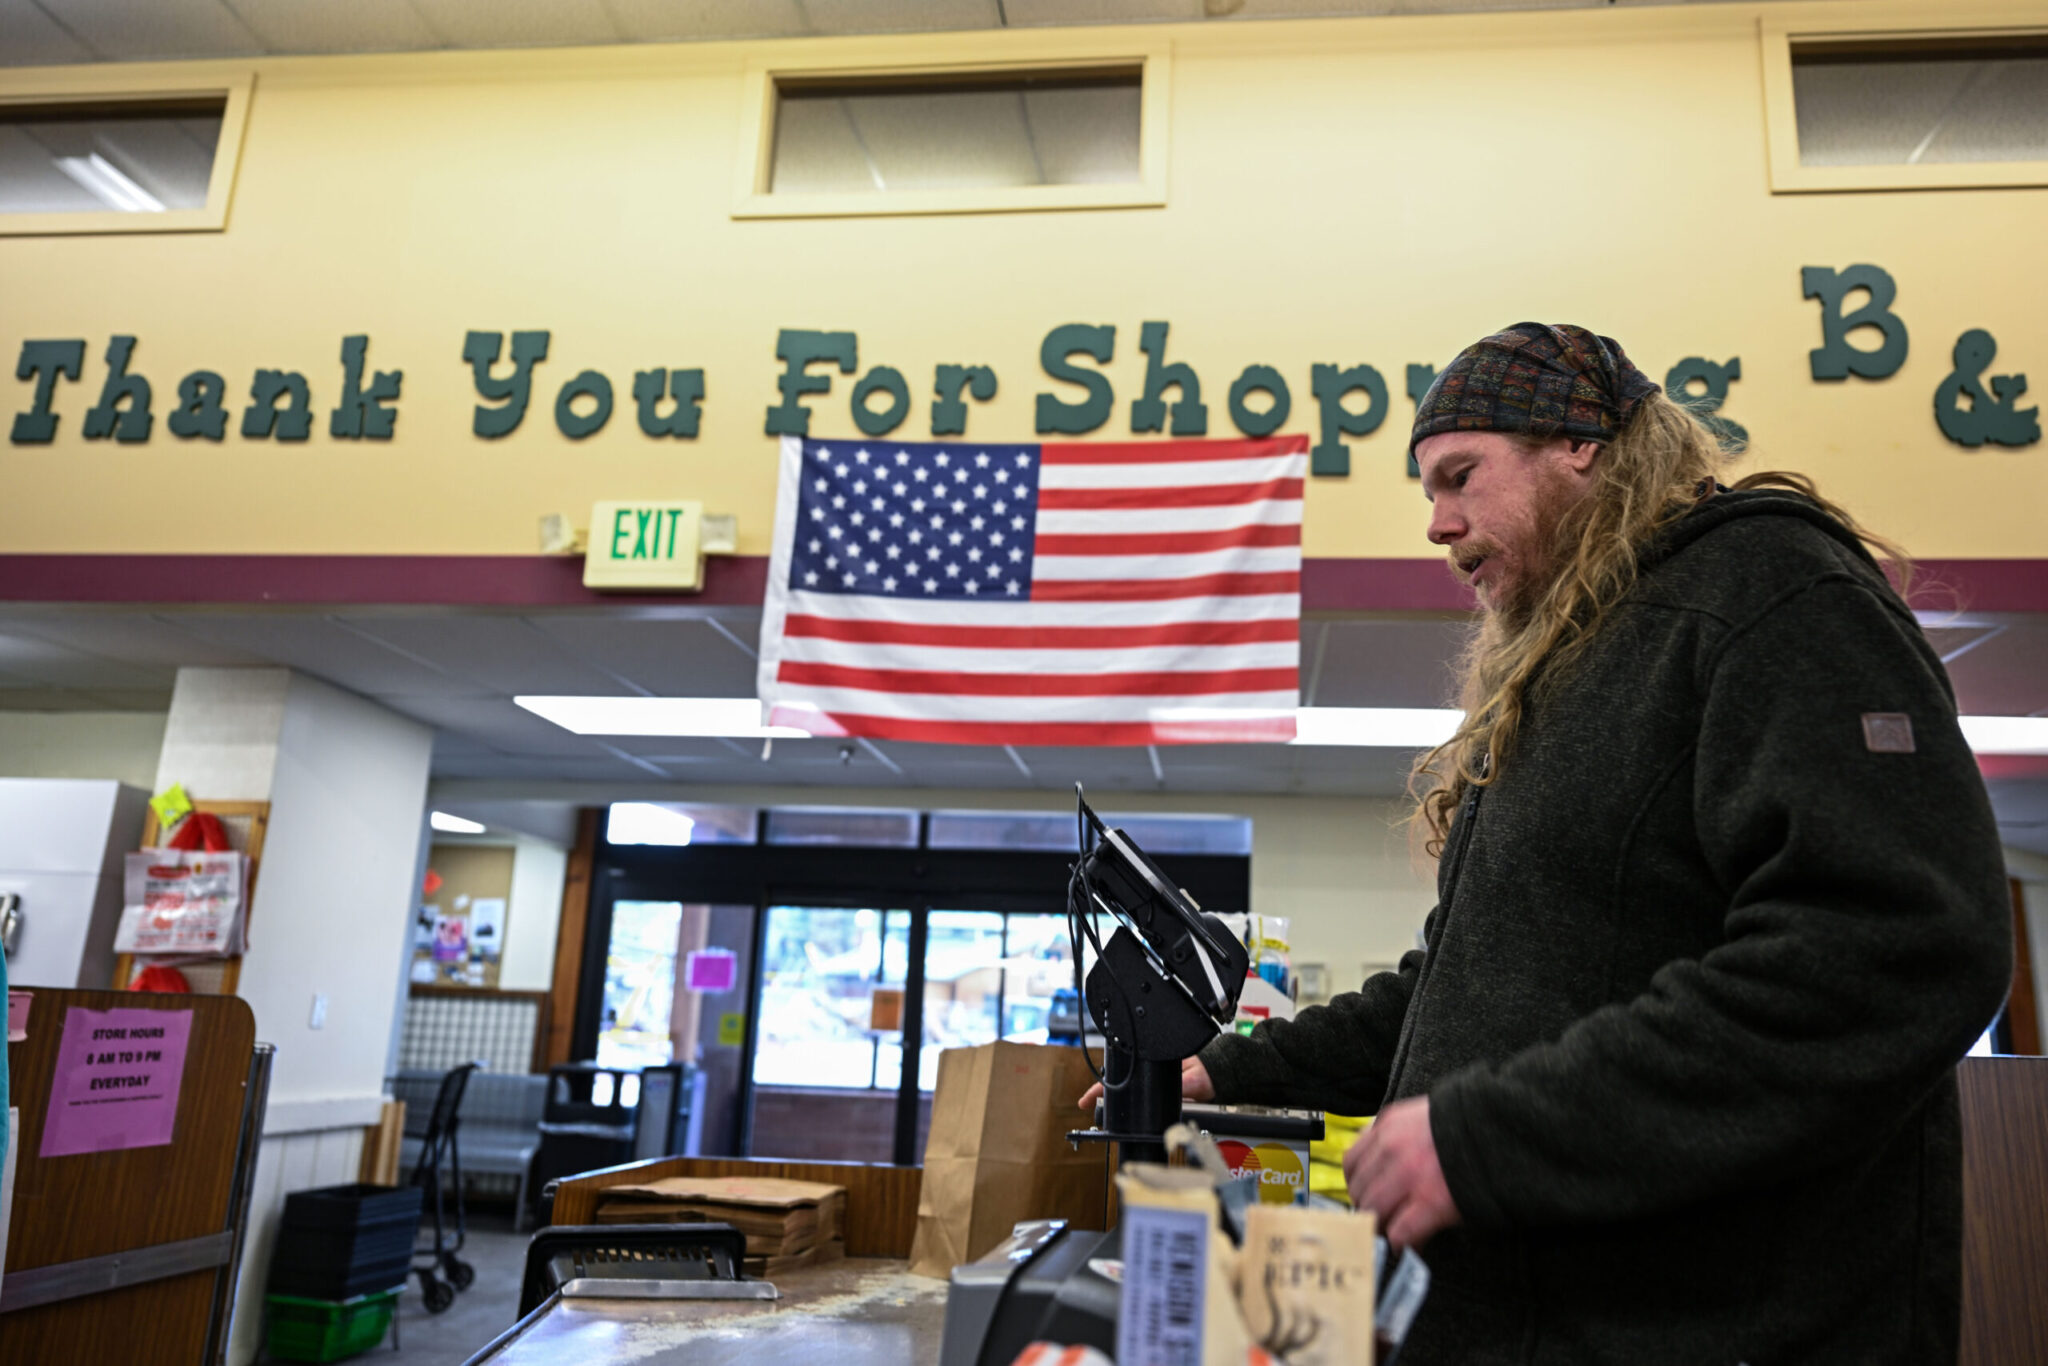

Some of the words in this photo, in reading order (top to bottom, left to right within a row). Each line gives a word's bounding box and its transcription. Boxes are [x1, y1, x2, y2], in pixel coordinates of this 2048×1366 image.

[1801, 264, 1909, 381] B
[1934, 328, 2041, 446] &
[10, 334, 404, 443] Thank
[462, 330, 706, 440] You
[765, 329, 998, 436] For
[1035, 320, 1749, 475] Shopg
[611, 508, 684, 559] EXIT
[93, 1029, 127, 1040] STORE
[130, 1028, 164, 1039] HOURS
[97, 1052, 115, 1064] AM
[119, 1051, 134, 1063] TO
[145, 1050, 162, 1062] PM
[90, 1076, 149, 1090] EVERYDAY
[1229, 1166, 1302, 1185] sterCard
